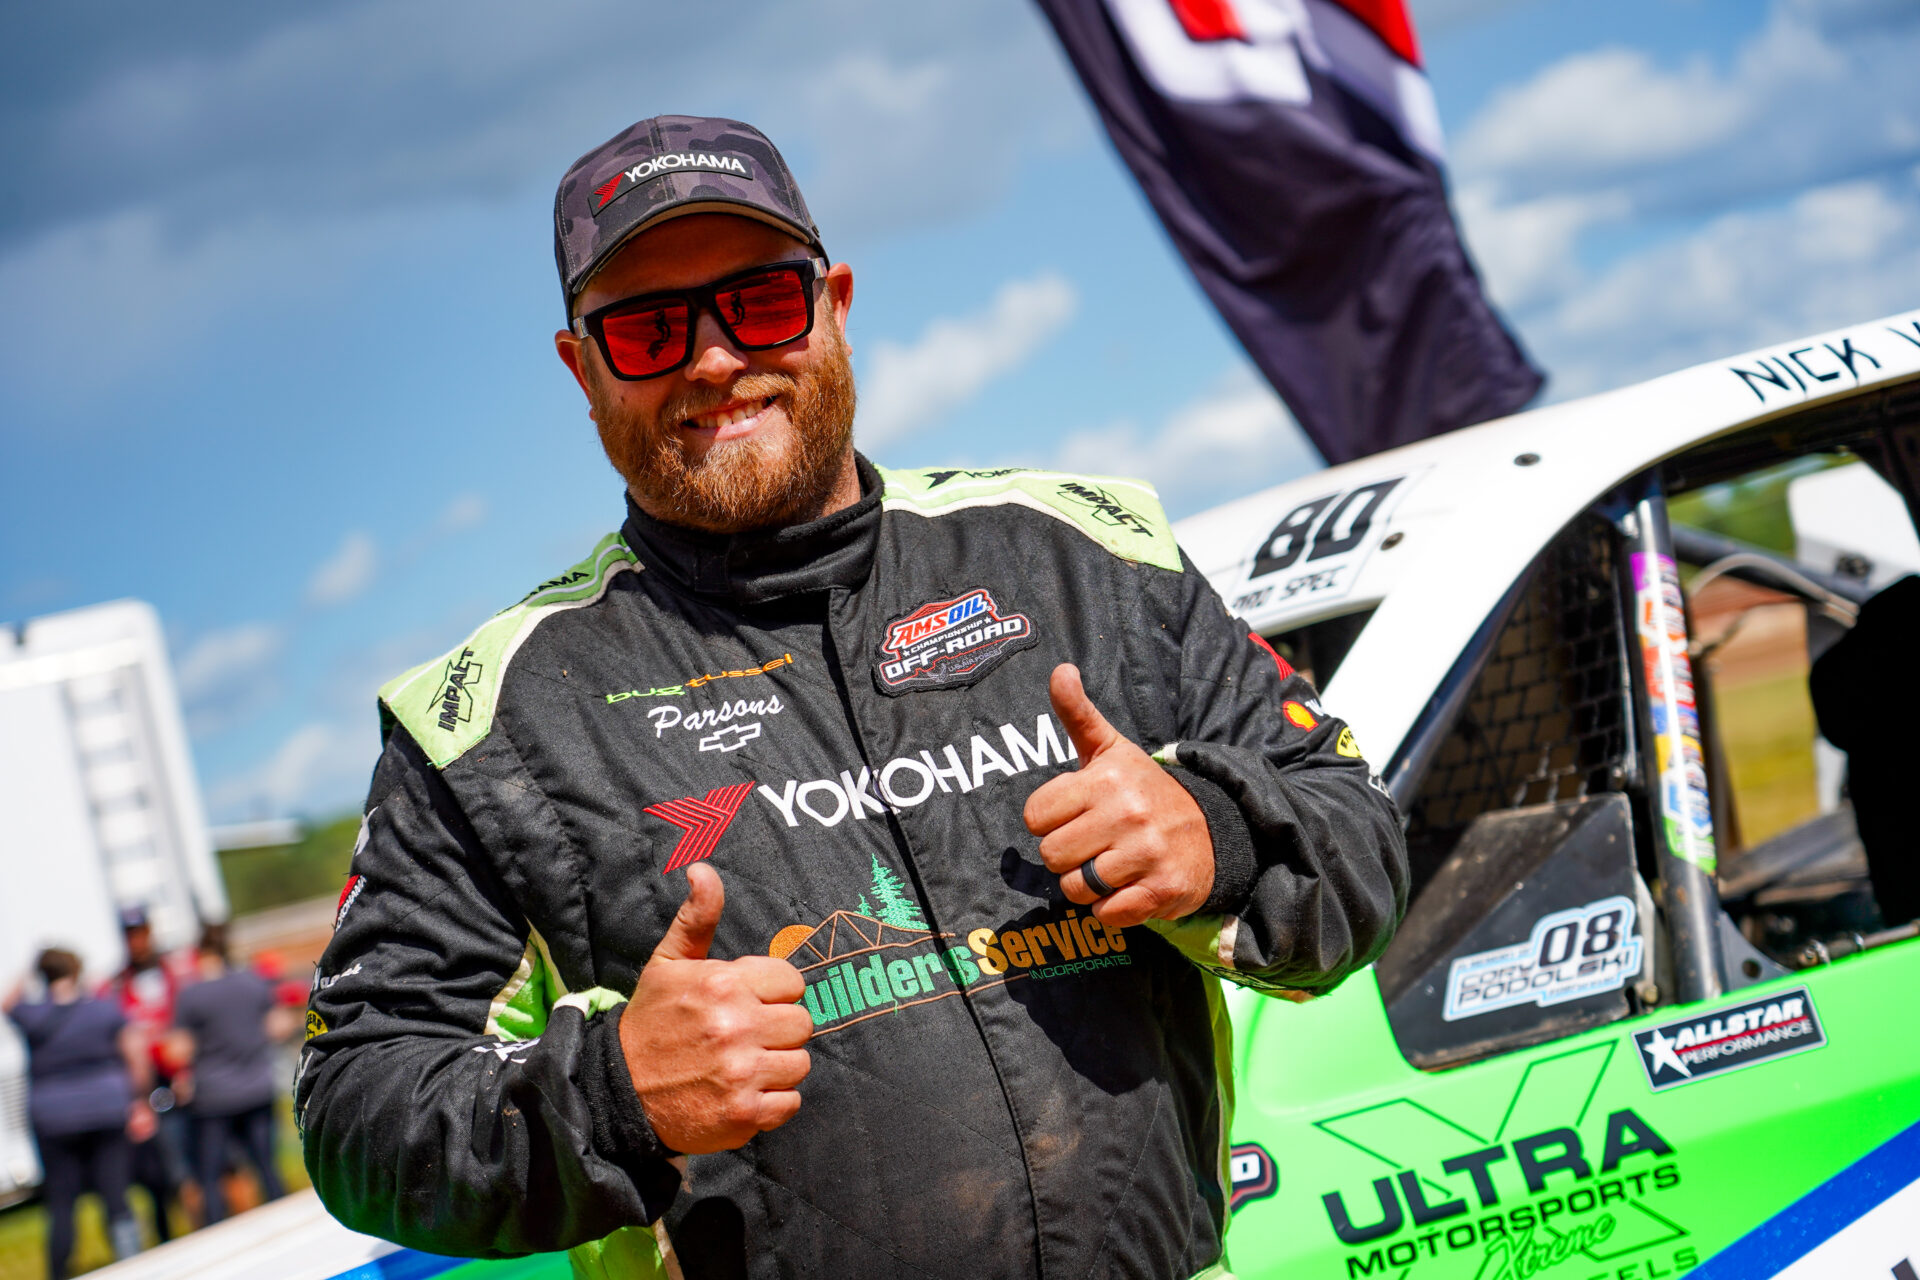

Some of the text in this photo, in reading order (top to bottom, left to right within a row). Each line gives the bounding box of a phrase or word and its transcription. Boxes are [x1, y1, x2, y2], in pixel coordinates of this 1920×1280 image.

[624, 153, 746, 182] YOKOHAMA
[1729, 338, 1882, 403] NICK
[1058, 482, 1154, 537] IMPACT
[1249, 477, 1406, 580] 80
[885, 618, 1022, 679] OFF-ROAD
[889, 594, 987, 649] AMSOIL
[911, 619, 984, 653] CHAMPIONSHIP
[438, 649, 474, 732] IMPACT
[647, 695, 784, 739] Parsons
[1539, 910, 1622, 968] 08
[796, 908, 1127, 1026] uilders Service
[1029, 954, 1132, 980] INCORPORATED
[1459, 951, 1631, 1005] PODOLSKI
[1462, 960, 1536, 989] CORY
[1674, 997, 1803, 1051] ALLSTAR
[1680, 1018, 1814, 1067] PERFORMANCE
[1321, 1108, 1676, 1246] ULTRA
[1346, 1164, 1681, 1280] MOTORSPORTS
